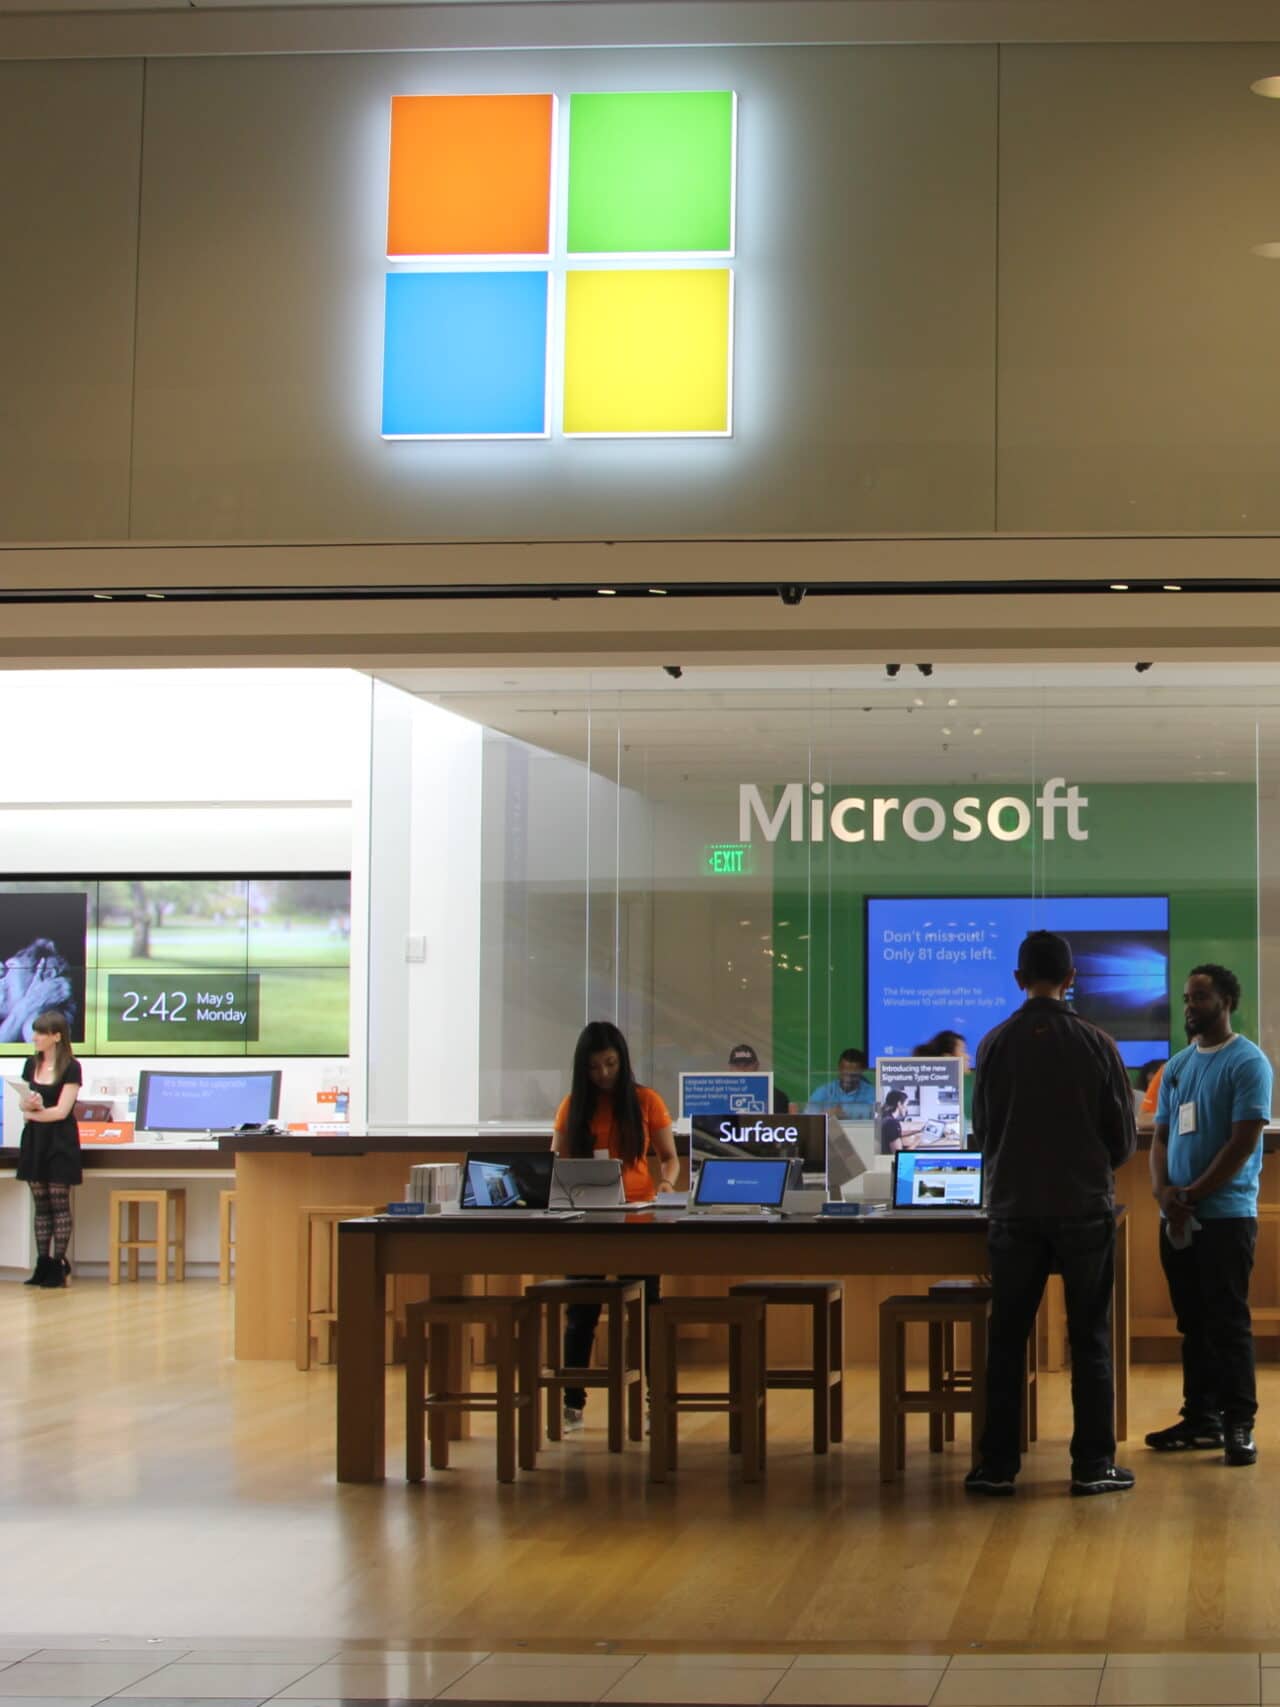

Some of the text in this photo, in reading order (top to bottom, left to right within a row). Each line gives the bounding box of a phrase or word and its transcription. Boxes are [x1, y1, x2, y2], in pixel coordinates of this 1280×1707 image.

[738, 777, 1089, 843] Microsoft
[714, 850, 745, 873] EXIT
[883, 929, 985, 943] Don't miss out!
[883, 947, 997, 965] Only 81 days left.
[121, 991, 188, 1022] 2:42
[197, 991, 234, 1007] May 9
[197, 1008, 247, 1024] Monday
[881, 1064, 920, 1073] Introducing
[920, 1064, 931, 1072] the
[882, 1073, 950, 1082] Signature Type Cover
[719, 1120, 799, 1143] Surface
